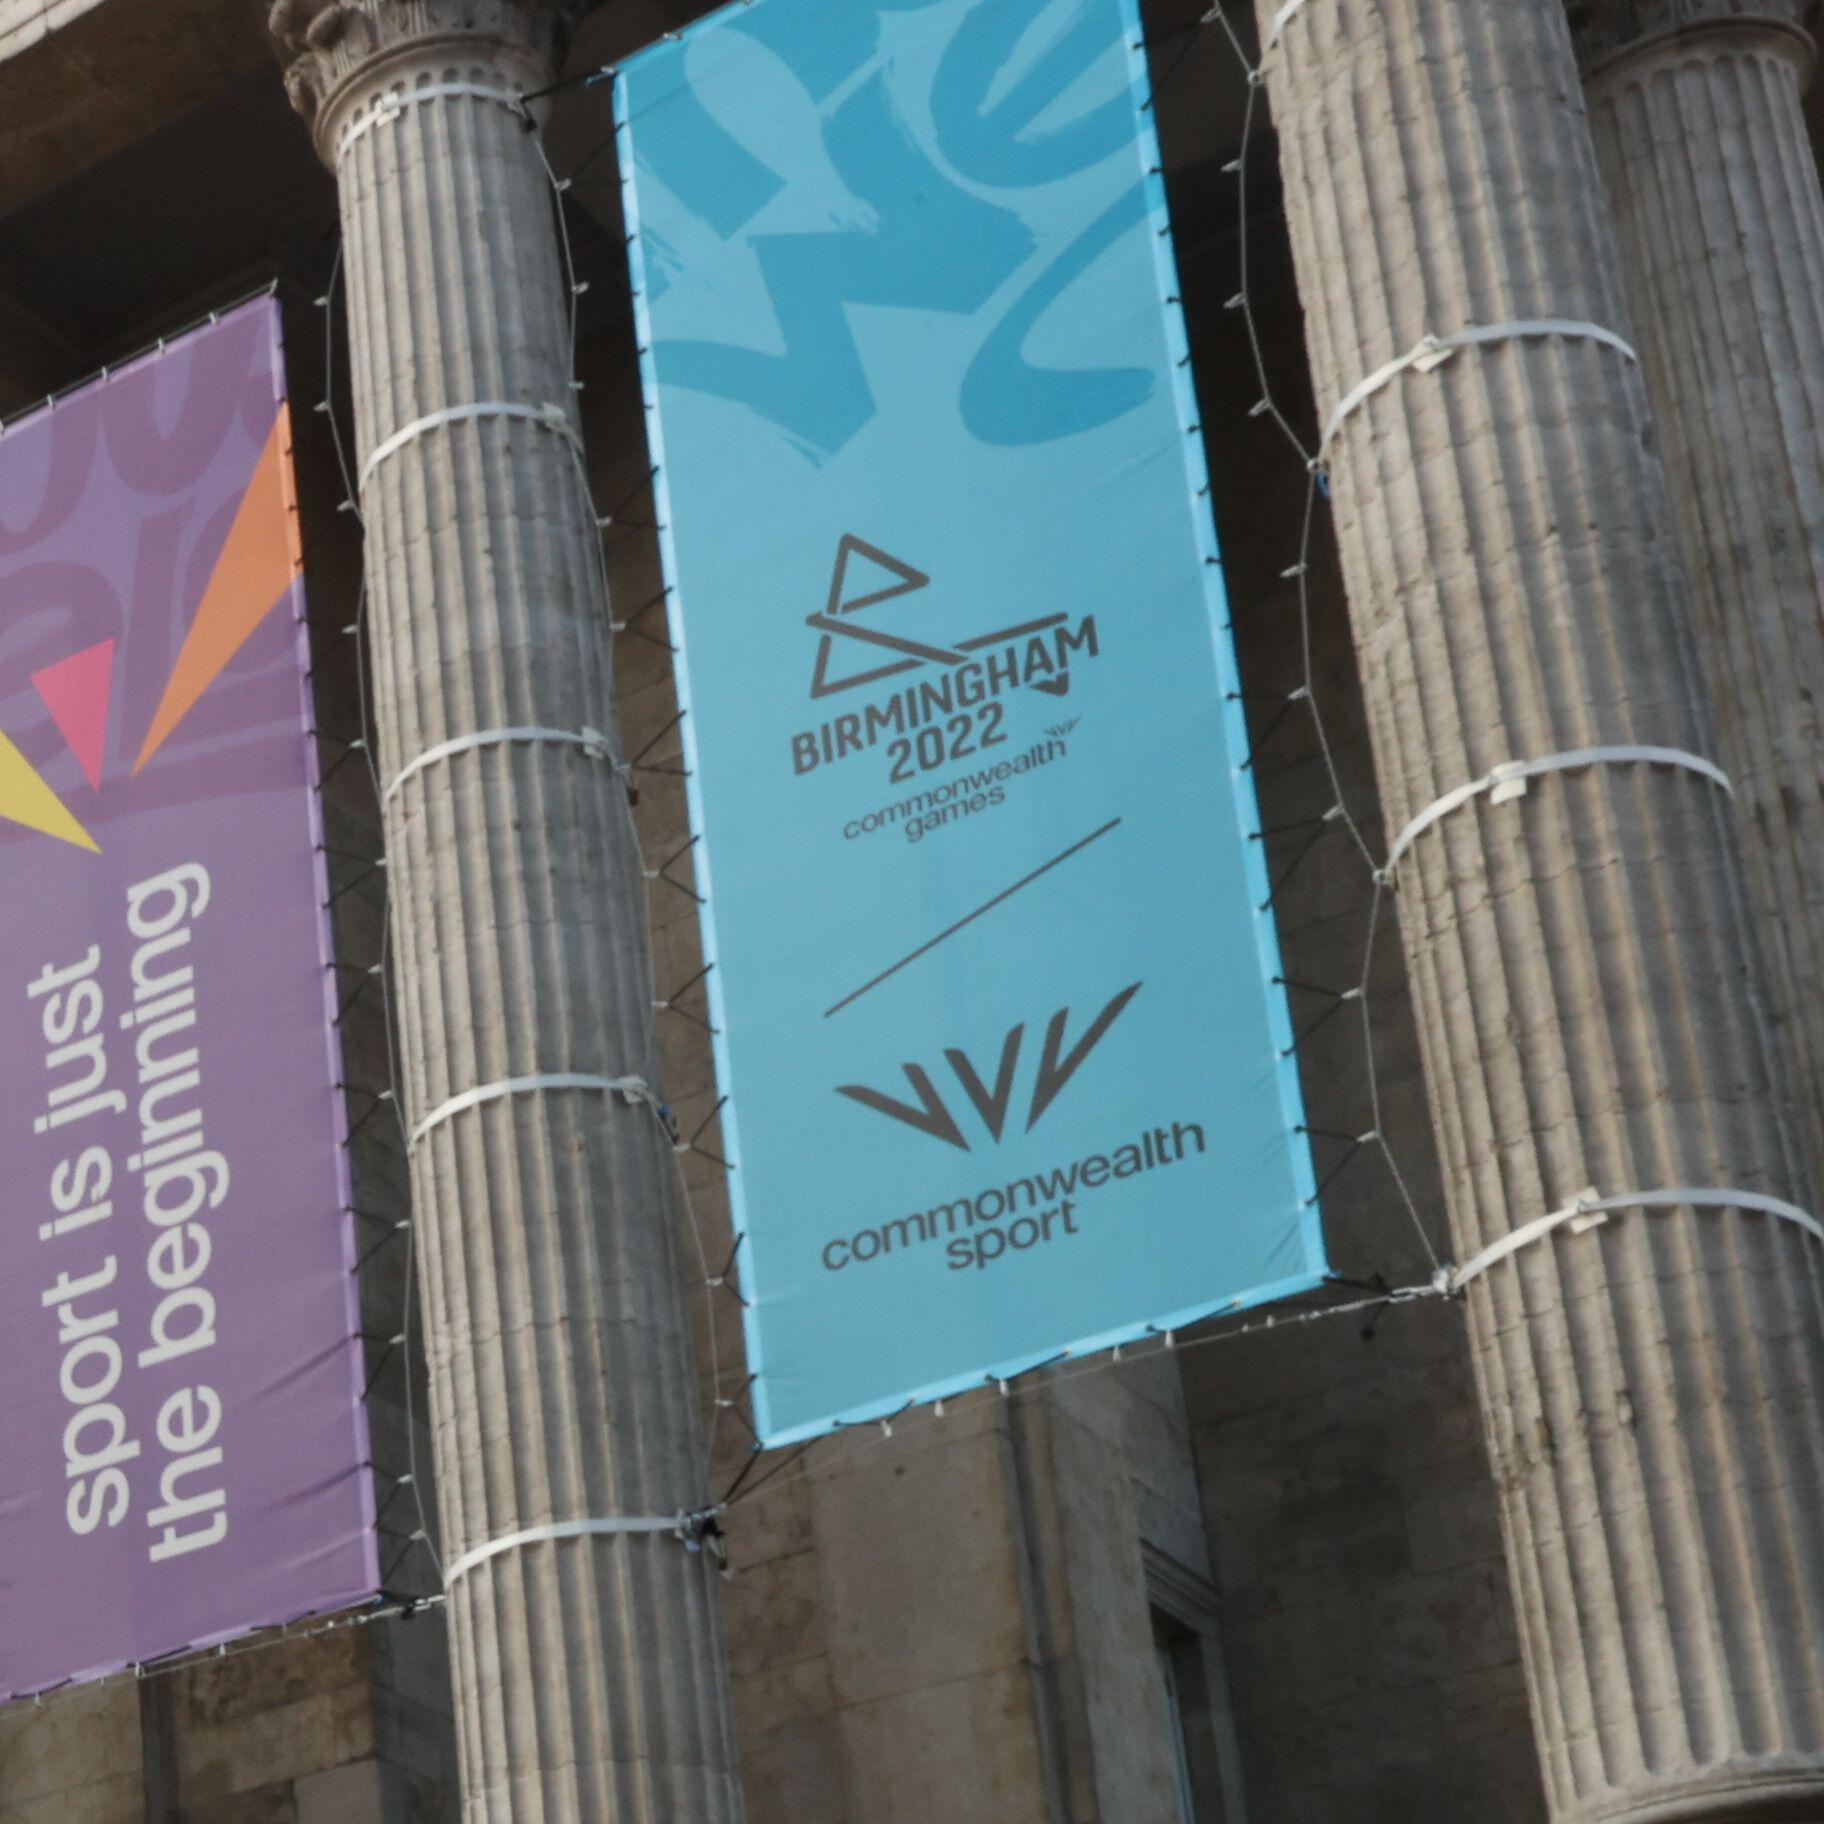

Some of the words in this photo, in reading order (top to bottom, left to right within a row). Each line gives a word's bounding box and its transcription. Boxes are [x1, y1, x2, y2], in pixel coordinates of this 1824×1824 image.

[791, 616, 1100, 776] BIRMINGHAM
[888, 702, 1008, 784] 2022
[842, 738, 1068, 840] commonwealth
[904, 784, 1007, 843] games
[27, 943, 127, 1136] just
[119, 859, 230, 1369] beginning
[39, 1146, 112, 1242] is
[820, 1119, 1207, 1271] commonwealth
[946, 1200, 1078, 1270] sport
[41, 1255, 140, 1536] sport
[148, 1381, 228, 1562] the
